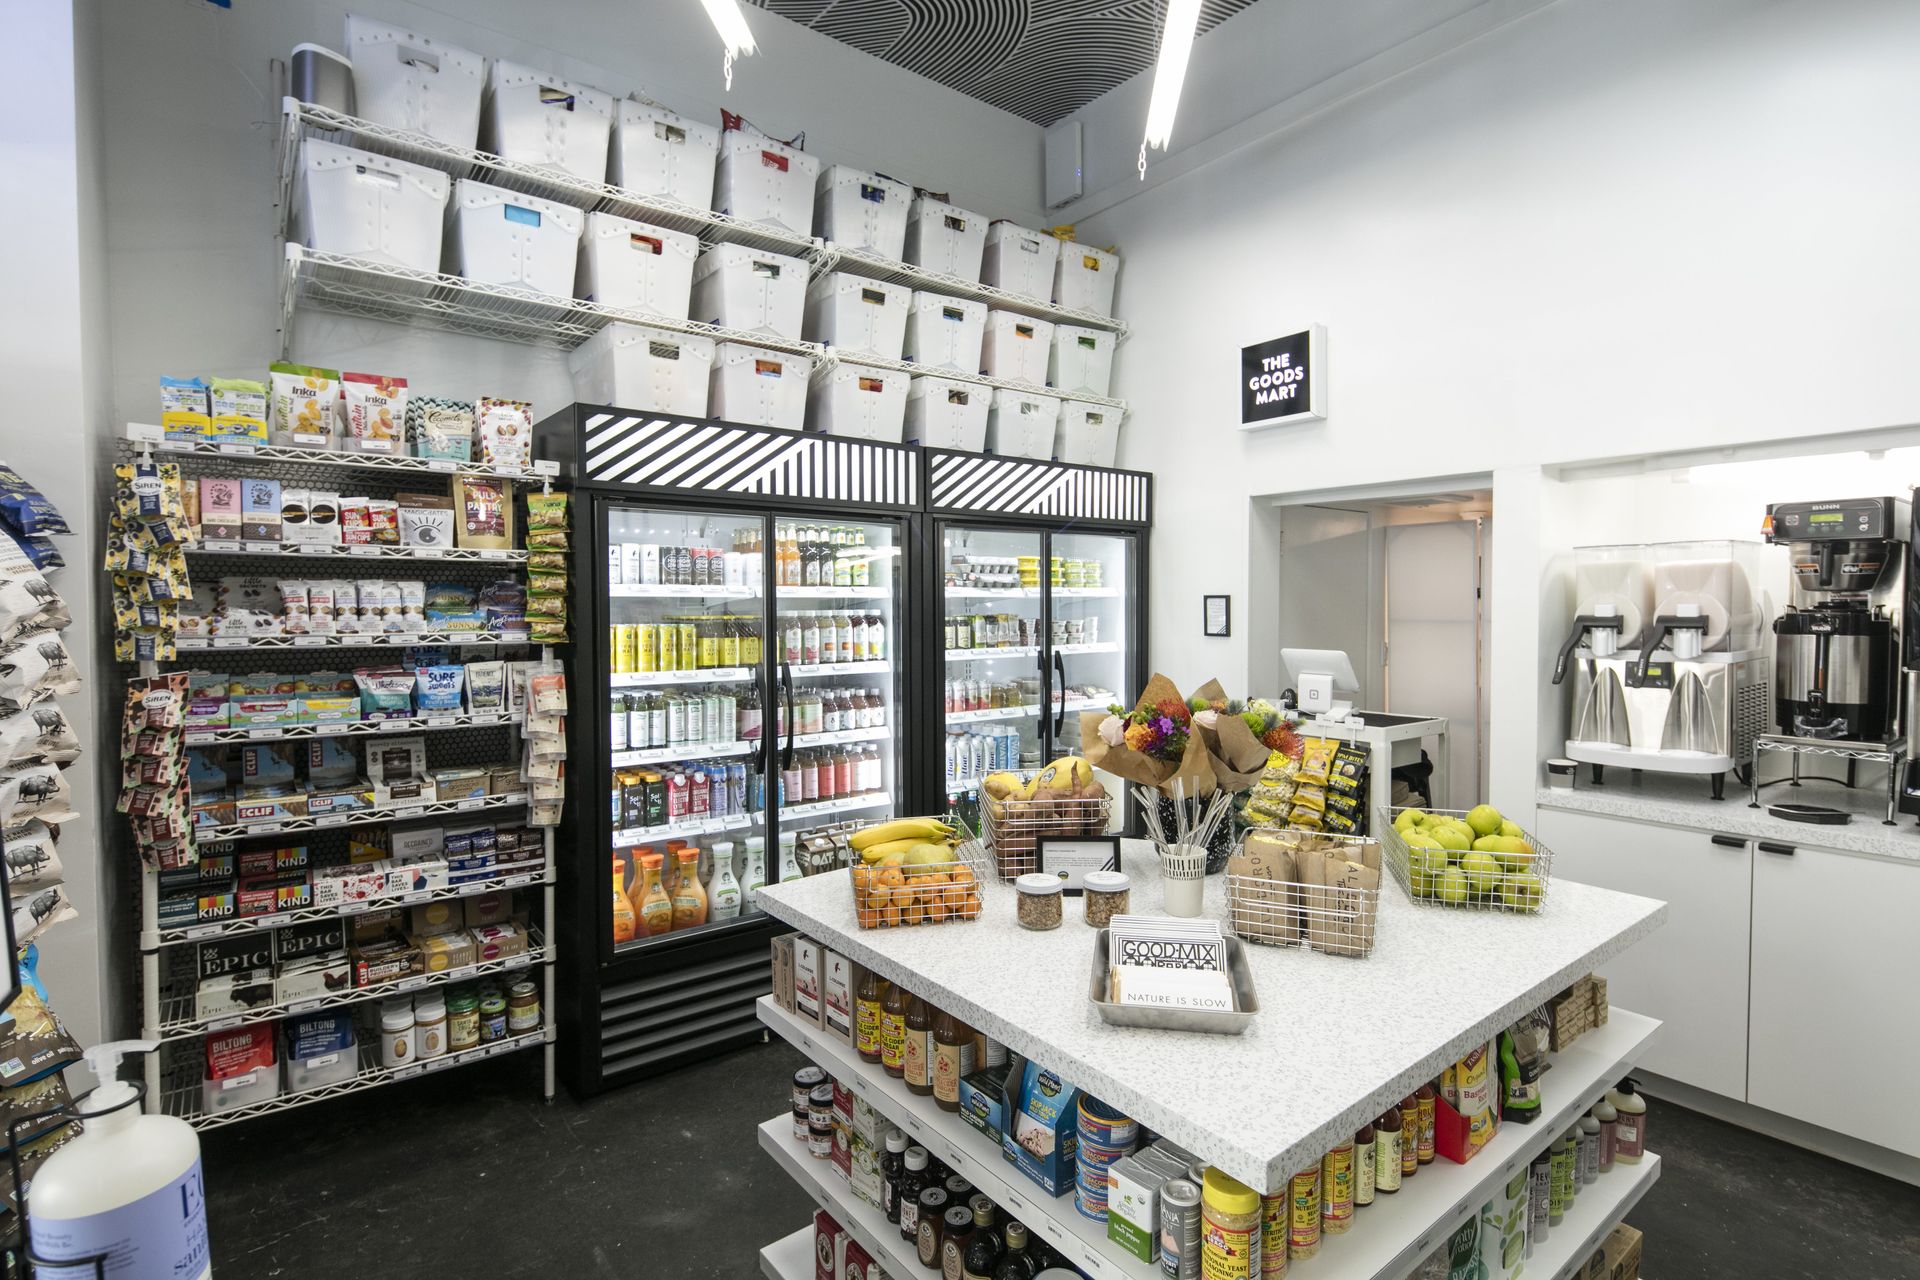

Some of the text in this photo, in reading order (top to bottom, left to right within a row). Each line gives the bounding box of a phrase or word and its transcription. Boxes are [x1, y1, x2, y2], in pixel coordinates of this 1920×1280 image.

[1262, 353, 1290, 372] THE
[1249, 366, 1304, 391] GOODS
[292, 386, 317, 397] Inka
[1255, 383, 1298, 405] MART
[365, 395, 387, 406] Inka
[473, 491, 496, 500] PULP
[467, 501, 503, 512] PANTRY
[344, 511, 360, 520] SUN
[372, 513, 388, 522] SUN
[428, 672, 455, 682] SURF
[1348, 755, 1364, 764] BITES
[246, 807, 273, 817] CLIF
[201, 842, 235, 854] KIND
[276, 857, 308, 868] KIND
[200, 866, 233, 878] KIND
[278, 896, 311, 909] KIND
[199, 905, 234, 919] KIND
[282, 930, 342, 954] EPIC
[206, 950, 269, 975] EPIC
[359, 968, 368, 984] CLIF
[1127, 993, 1227, 1008] NATURE IS SLOW
[300, 1019, 336, 1034] BILTONG
[863, 1023, 880, 1031] CIDER
[212, 1034, 253, 1053] BILTONG
[31, 1055, 47, 1065] olive
[46, 1050, 55, 1059] oil
[1227, 1264, 1248, 1272] YEAST
